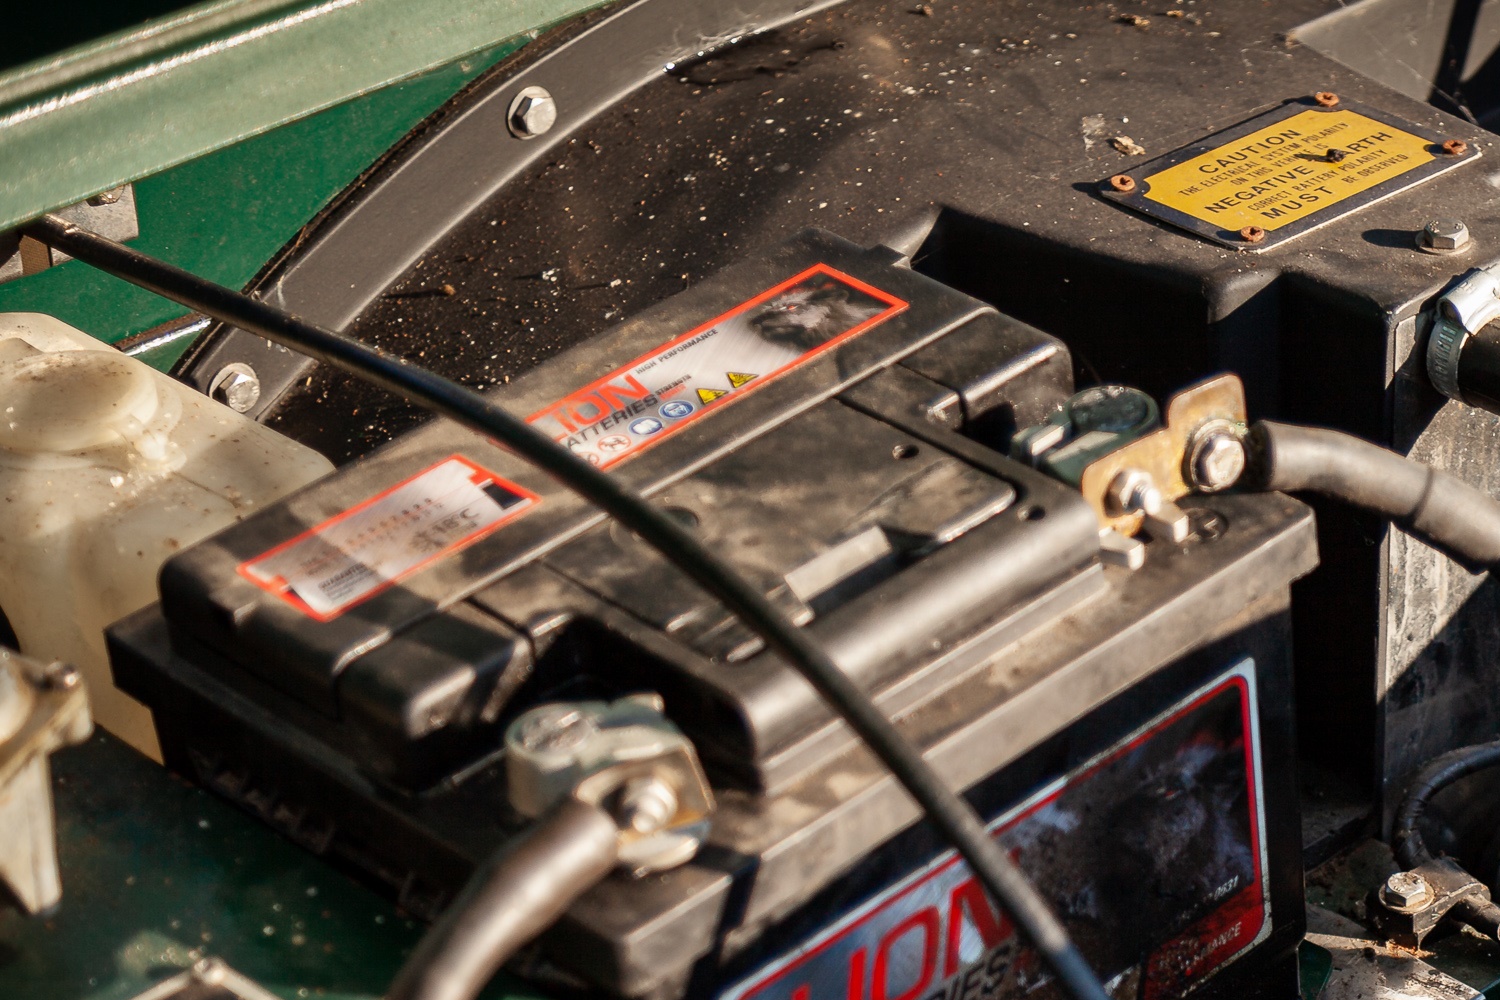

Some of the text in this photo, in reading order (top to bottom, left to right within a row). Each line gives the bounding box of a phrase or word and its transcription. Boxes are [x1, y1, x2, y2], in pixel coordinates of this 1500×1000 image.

[1178, 121, 1349, 197] THE ELECTRICAL SYSTEM POLARITY
[1198, 129, 1302, 174] CAUTION
[1229, 176, 1250, 187] ON
[1245, 166, 1274, 179] THIS
[1313, 142, 1329, 151] IS
[1246, 148, 1388, 212] CORRECT BATTERY POLARITY
[1204, 164, 1315, 214] NEGATIVE
[1259, 152, 1409, 220] MUST BE OBSERVED
[635, 327, 719, 375] HIGH PERFORMANCE
[552, 373, 661, 442] ION
[565, 392, 660, 451] ATTERIES
